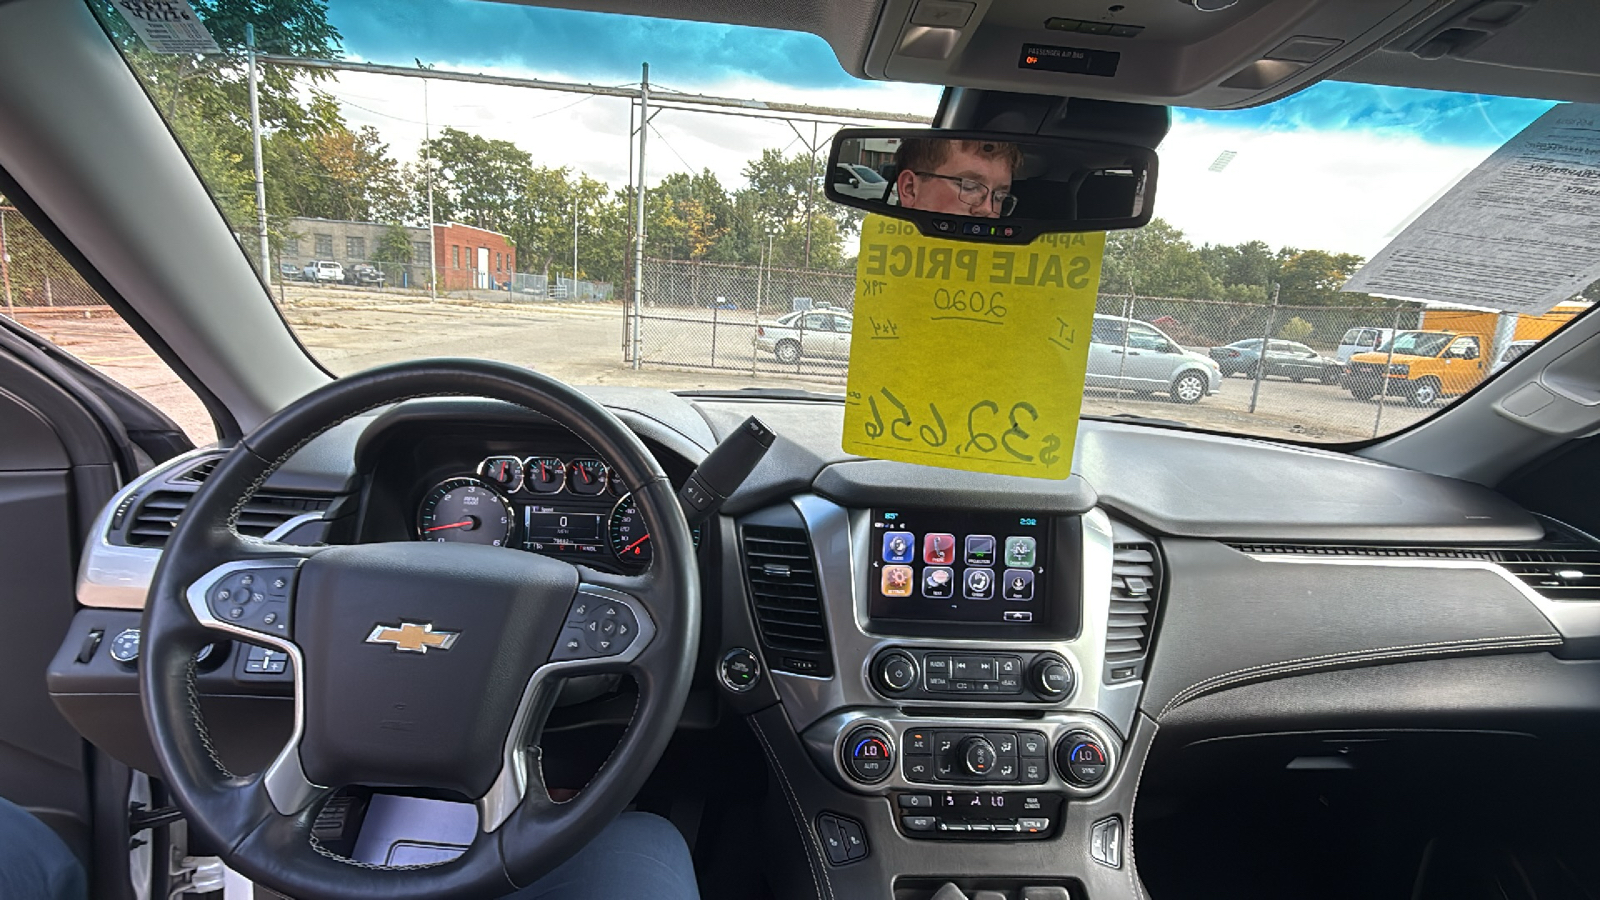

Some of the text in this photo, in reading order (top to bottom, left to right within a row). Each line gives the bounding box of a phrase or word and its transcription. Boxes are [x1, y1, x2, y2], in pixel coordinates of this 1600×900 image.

[500, 516, 507, 524] 5
[559, 516, 568, 527] 0
[492, 539, 501, 547] 6
[864, 745, 878, 756] LO
[1079, 750, 1092, 761] LO
[991, 796, 1004, 807] LO
